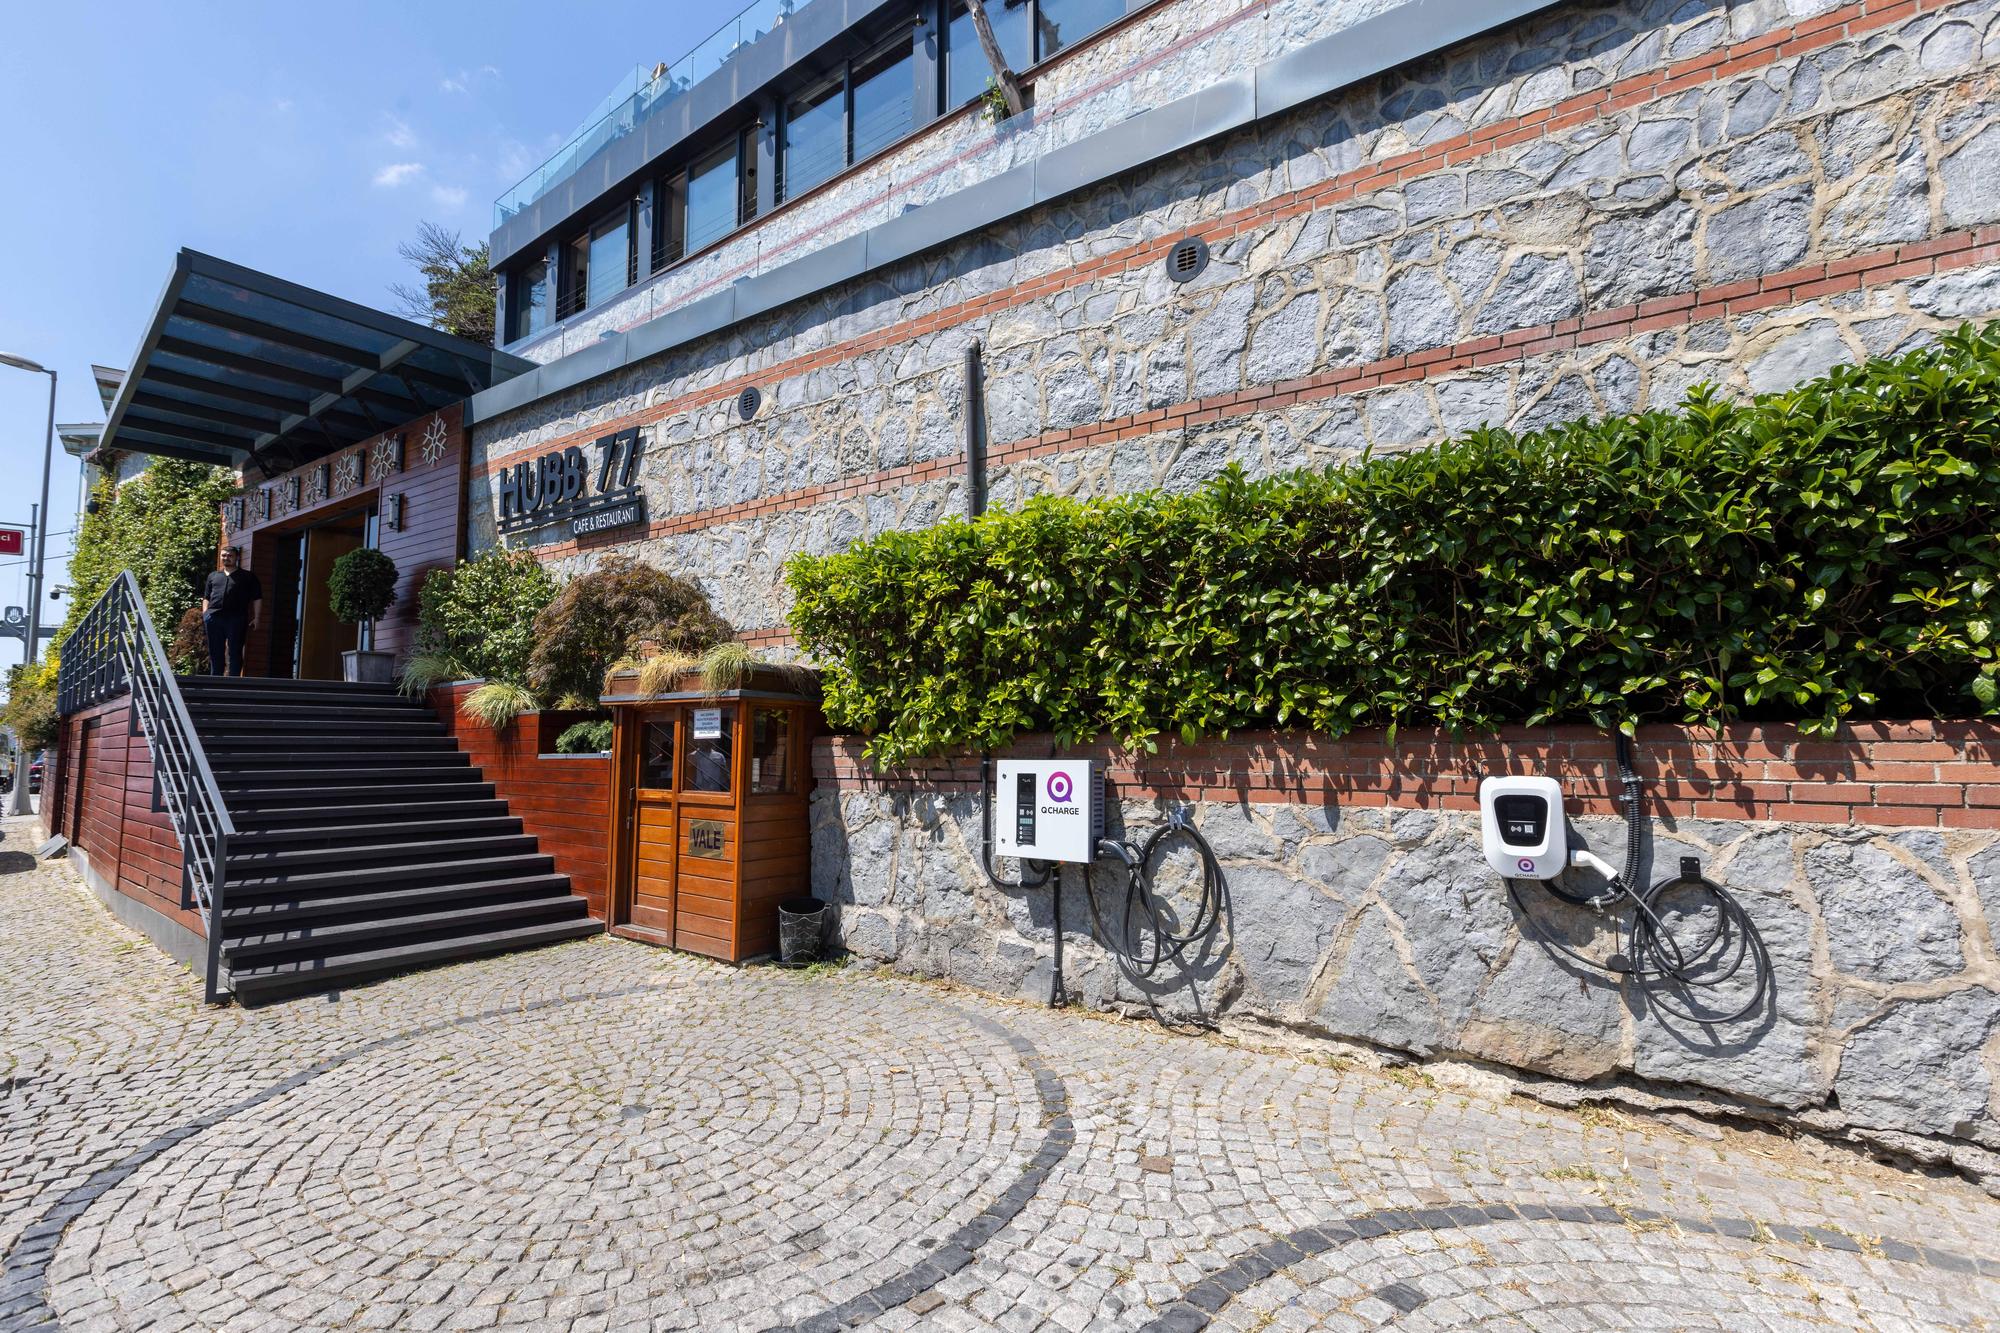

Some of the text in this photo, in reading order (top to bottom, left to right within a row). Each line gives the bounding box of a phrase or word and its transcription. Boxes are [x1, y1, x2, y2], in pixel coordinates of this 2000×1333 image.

[499, 425, 641, 518] HUBB 77
[573, 518, 589, 534] CAFE
[595, 507, 635, 528] RESTAURANT
[1041, 806, 1080, 816] QCHARGE
[692, 828, 721, 850] VALE
